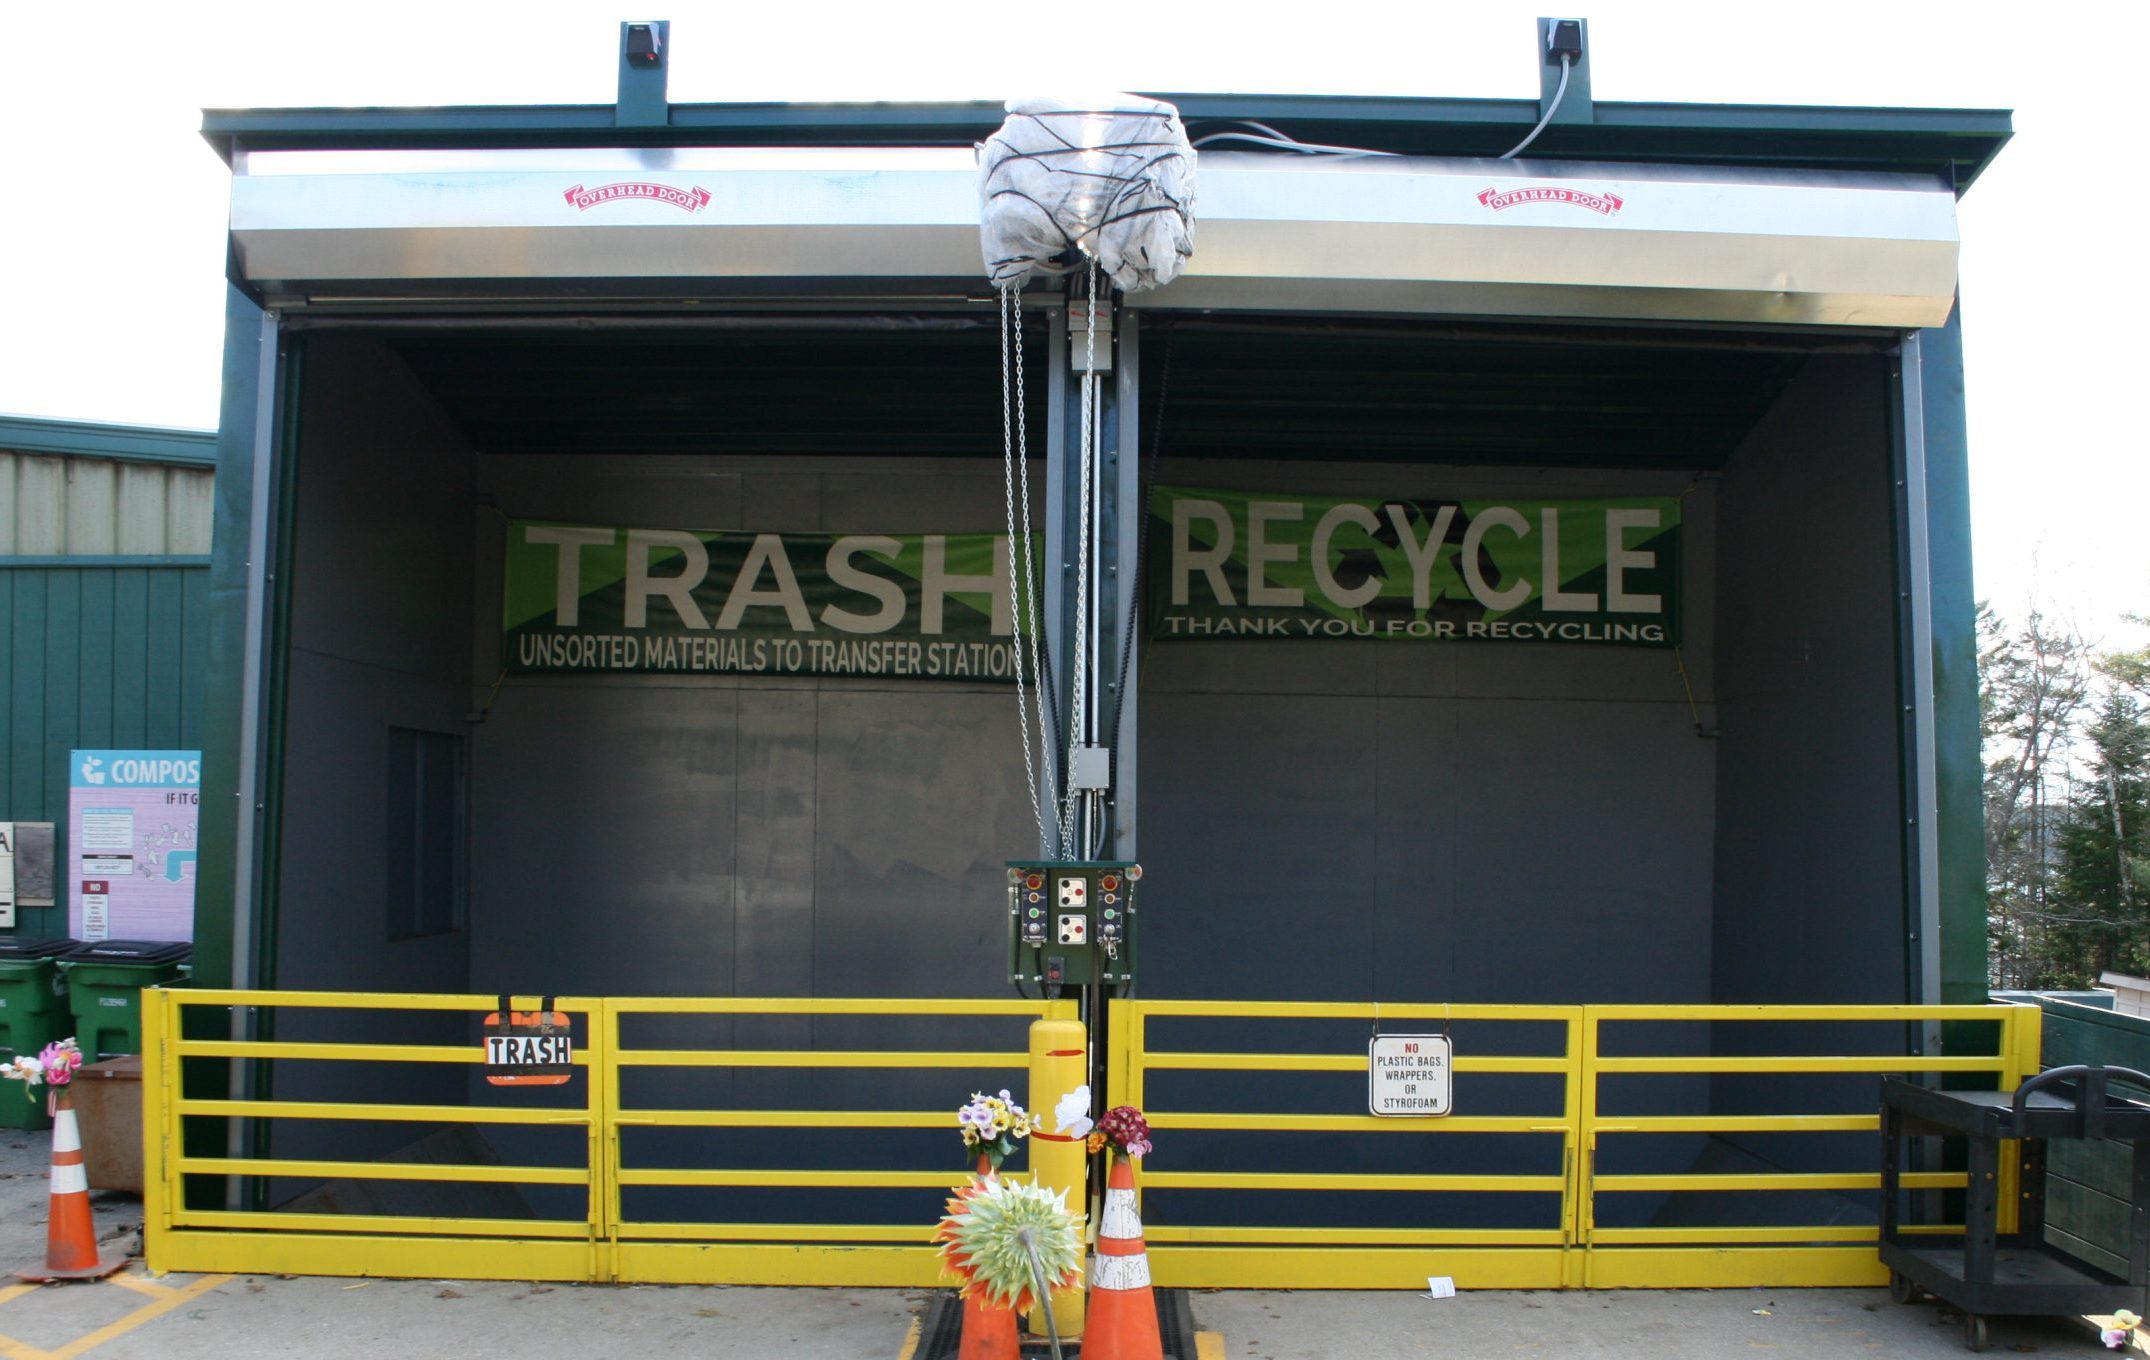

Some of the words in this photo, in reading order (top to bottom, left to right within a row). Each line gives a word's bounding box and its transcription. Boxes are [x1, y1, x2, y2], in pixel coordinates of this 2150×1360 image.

[580, 185, 655, 206] OVERHEAD
[658, 188, 694, 208] DOOR
[1493, 190, 1567, 208] OVERHEAD
[1572, 193, 1607, 211] DOOR
[1171, 499, 1662, 614] RECYCLE
[525, 525, 1014, 636] TRASH
[1164, 616, 1289, 635] THANK
[1299, 618, 1376, 637] YOU
[1386, 619, 1457, 638] FOR
[1467, 620, 1664, 642] RECYCLING
[520, 633, 638, 668] UNSORTED
[644, 636, 766, 671] MATERIALS
[773, 639, 801, 671] TO
[808, 640, 922, 674] TRANSFER
[927, 642, 1022, 677] STATION
[111, 759, 200, 784] COMPOS
[166, 792, 176, 805] IF
[178, 792, 188, 805] IT
[490, 1037, 569, 1065] TRASH
[1404, 1043, 1419, 1053] NO
[1377, 1056, 1414, 1066] PLASTIC
[1404, 1084, 1416, 1094] OR
[1384, 1098, 1438, 1108] STYROFOAM
